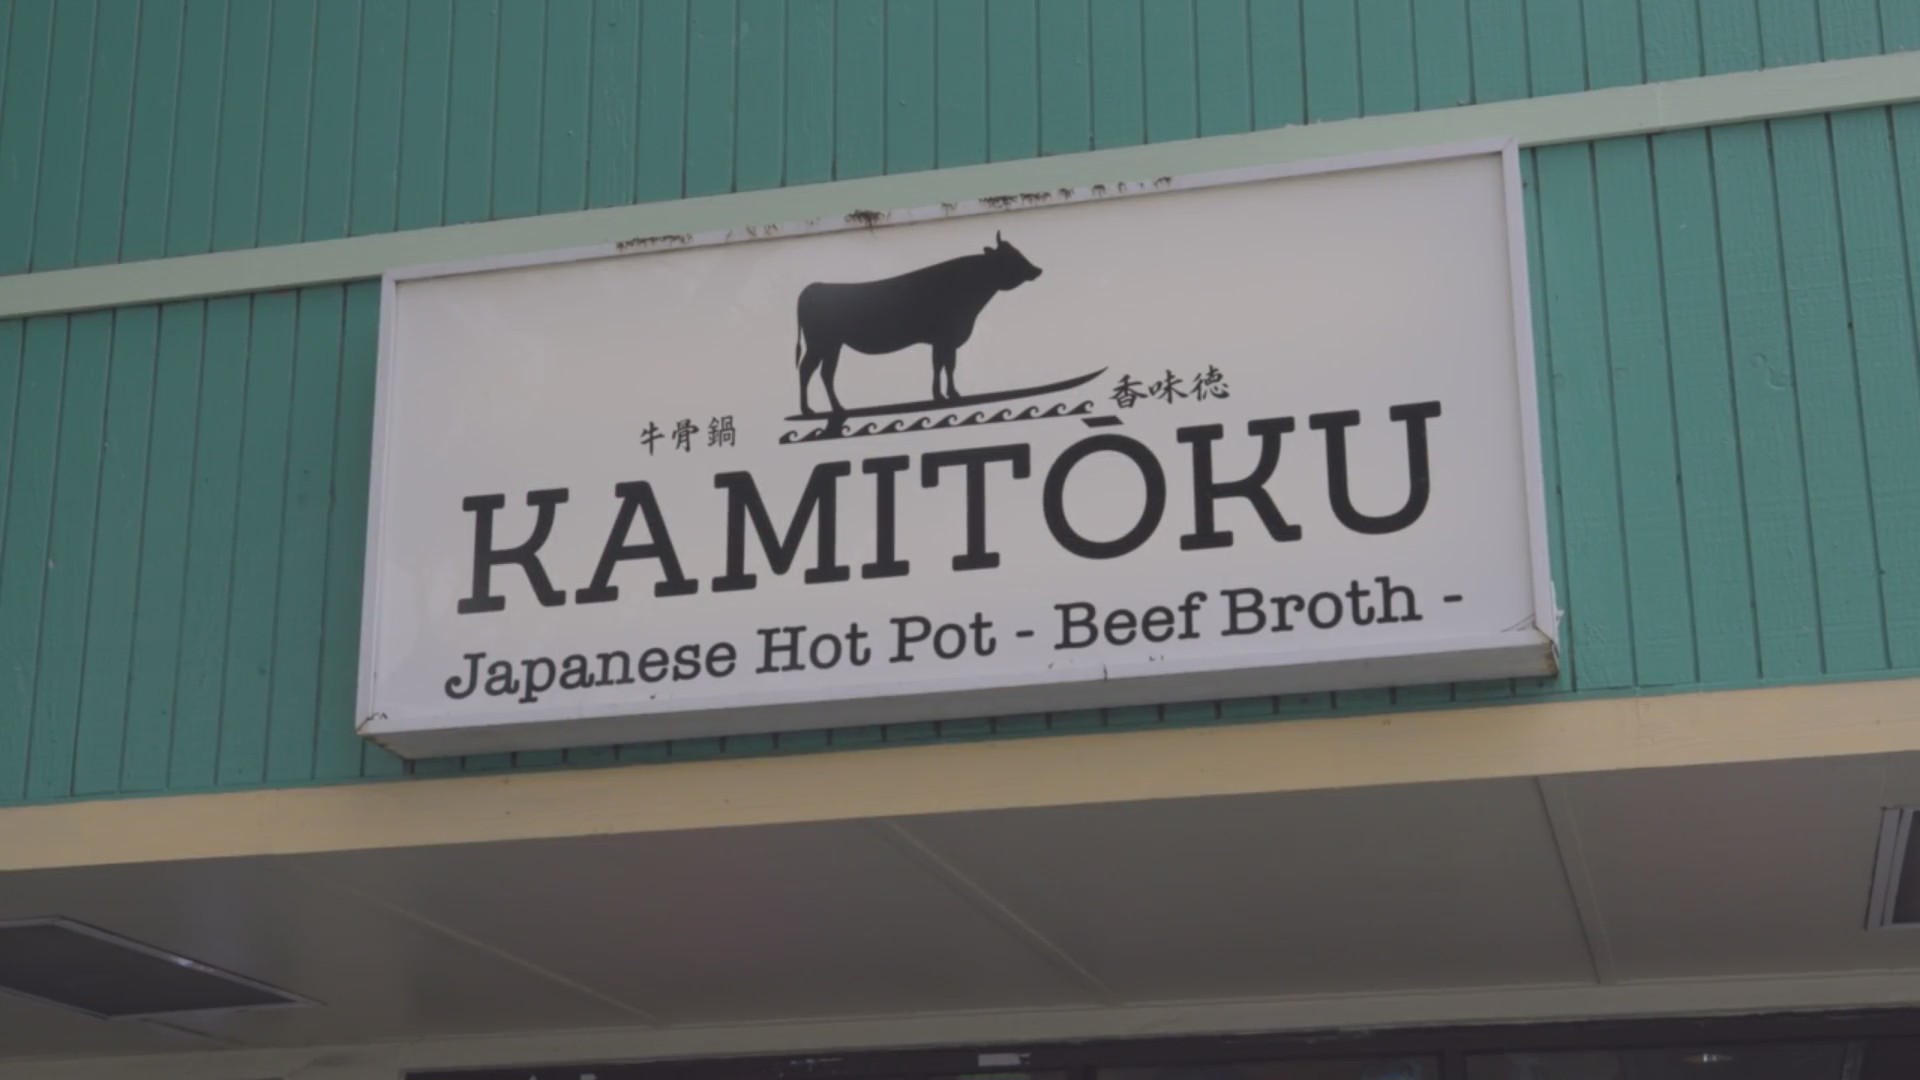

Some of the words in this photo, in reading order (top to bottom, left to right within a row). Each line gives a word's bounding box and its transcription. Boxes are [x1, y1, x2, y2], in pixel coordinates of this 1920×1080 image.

[639, 414, 738, 456] 牛骨鍋
[444, 636, 737, 705] Japanese
[755, 622, 871, 675] Hot
[889, 612, 997, 664] Pot
[1053, 590, 1208, 651] Beef
[1220, 575, 1424, 638] Broth
